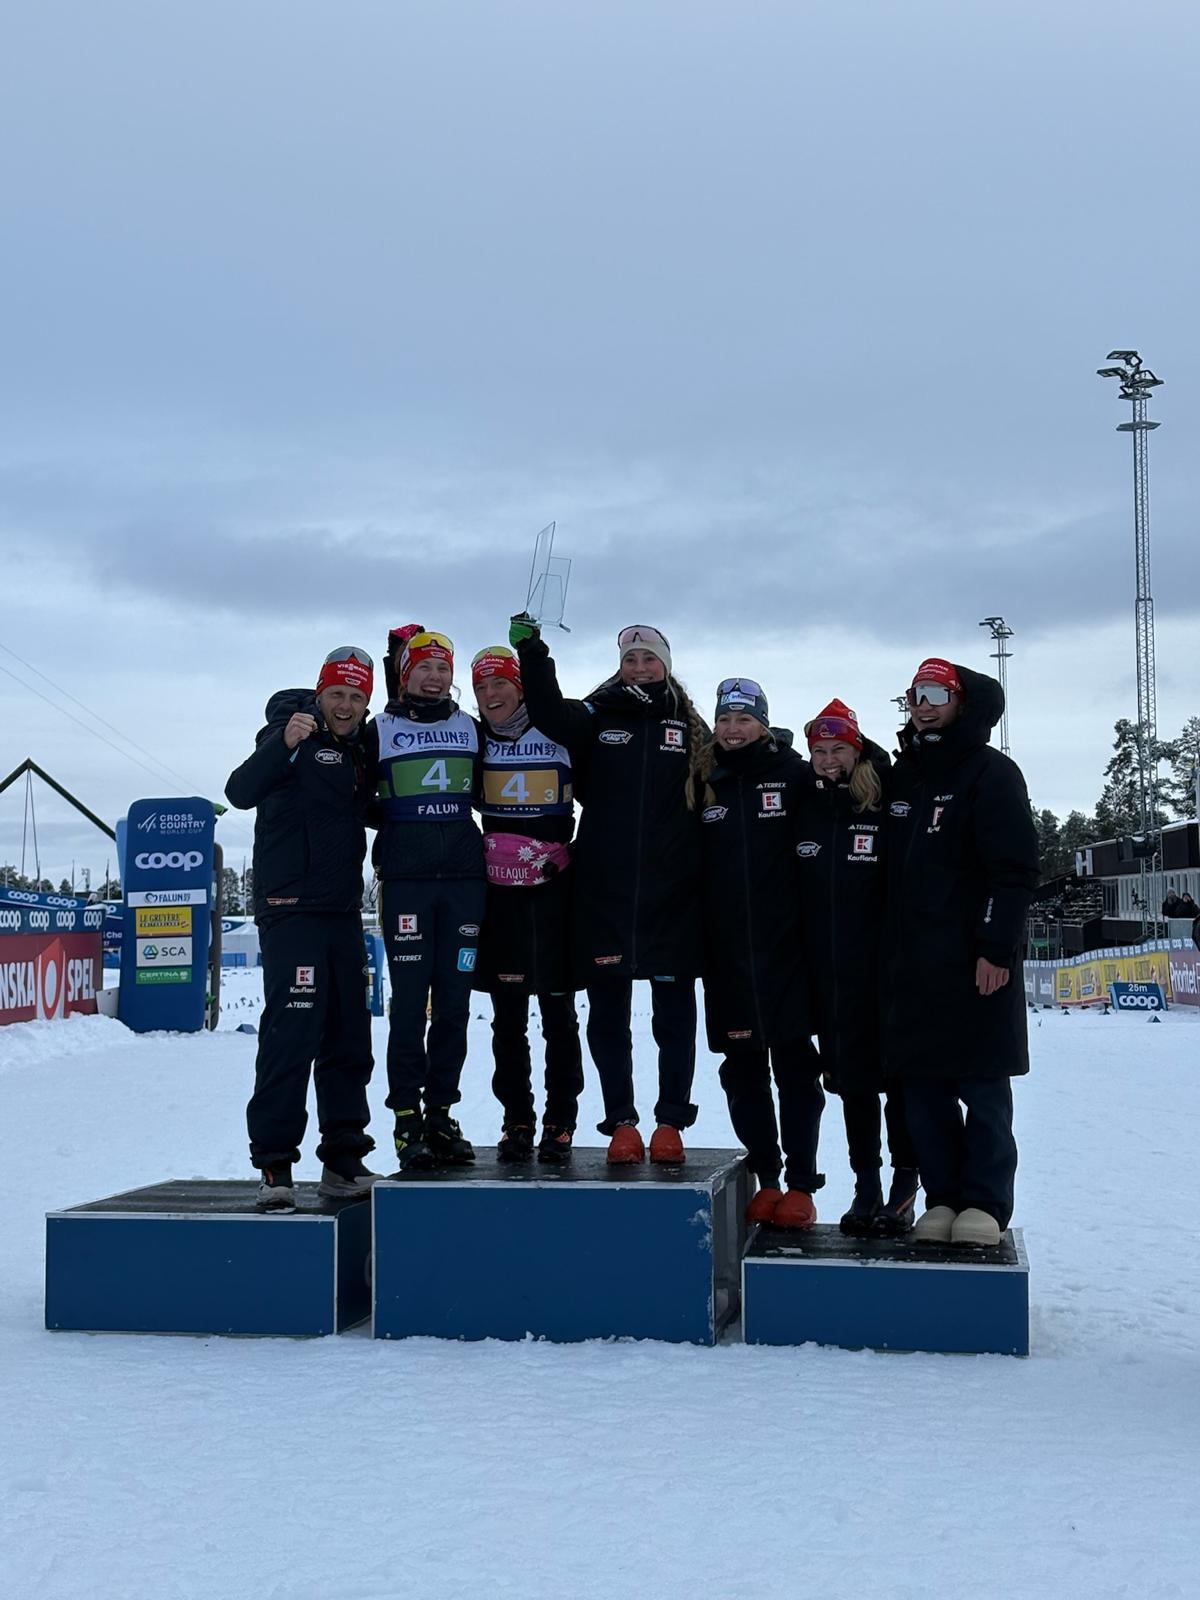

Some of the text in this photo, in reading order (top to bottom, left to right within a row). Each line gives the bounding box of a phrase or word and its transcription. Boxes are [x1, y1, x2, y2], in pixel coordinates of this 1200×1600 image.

[417, 731, 458, 745] FALUN
[501, 743, 543, 757] FALUN
[421, 759, 451, 793] 4
[462, 777, 470, 791] 2
[500, 773, 529, 803] 4
[544, 789, 555, 802] 3
[417, 803, 459, 815] FALUN
[758, 810, 787, 819] Kaufland
[159, 813, 194, 822] CROSS
[159, 820, 206, 830] COUNTRY
[135, 850, 204, 872] coop
[847, 854, 878, 862] Kaufland
[8, 890, 39, 903] coop
[47, 896, 78, 908] coop
[159, 893, 183, 903] FALUN
[30, 911, 50, 932] coop
[56, 911, 76, 931] coop
[84, 911, 103, 930] coop
[394, 933, 423, 942] Kaufland
[161, 946, 187, 957] SCA
[67, 958, 96, 1002] SPEL
[139, 971, 179, 979] CERTINA
[1128, 983, 1148, 993] 25m
[1118, 995, 1159, 1010] coop
